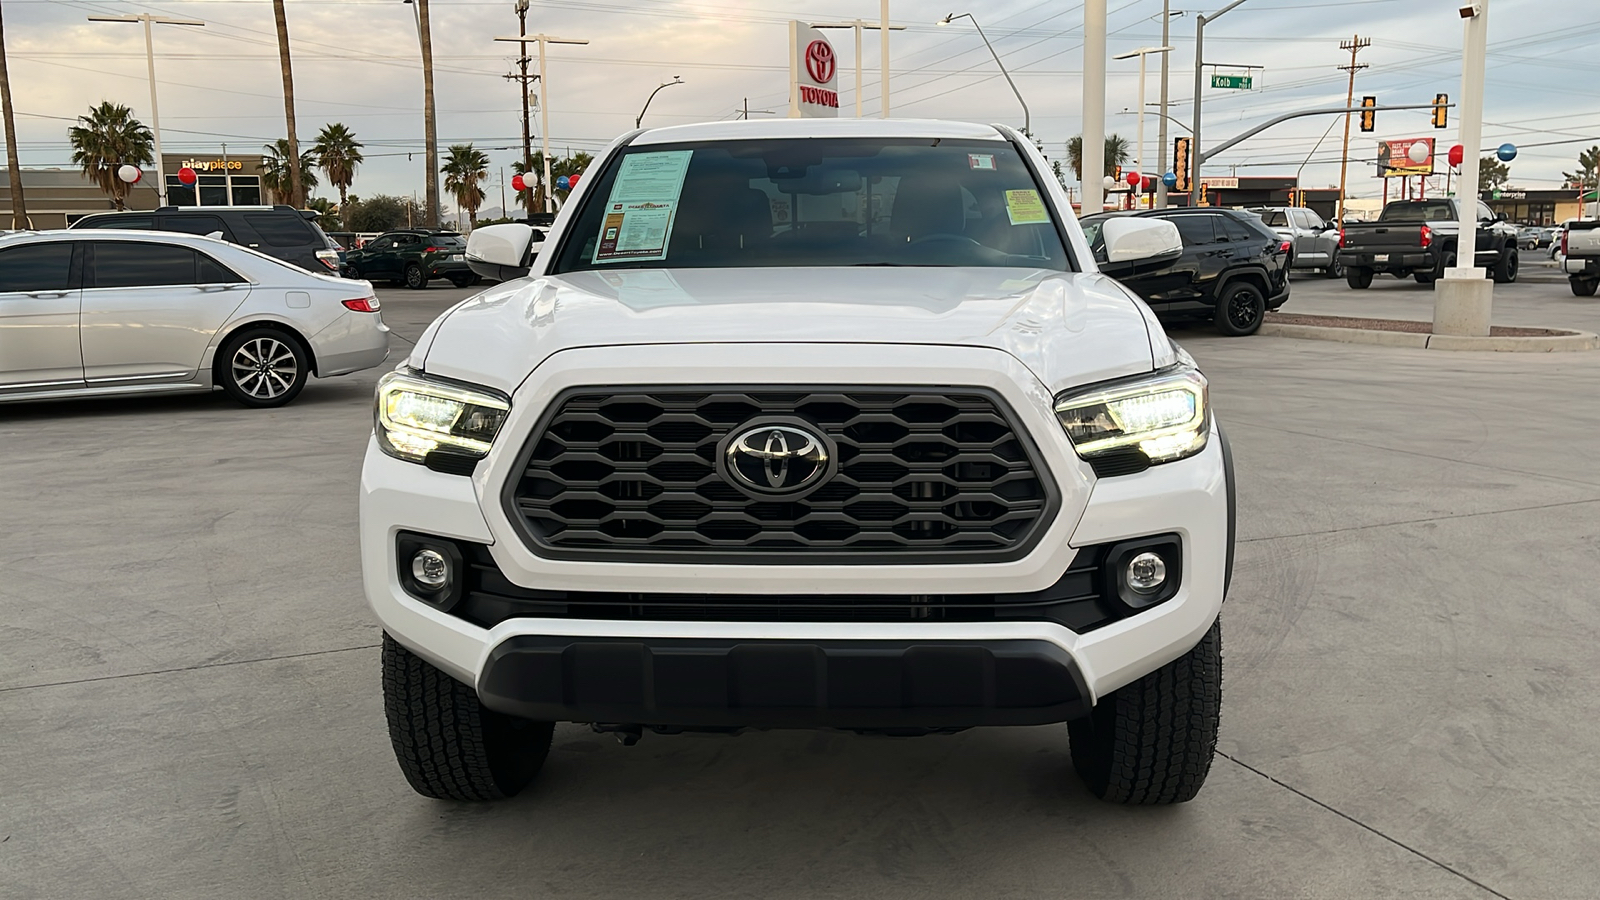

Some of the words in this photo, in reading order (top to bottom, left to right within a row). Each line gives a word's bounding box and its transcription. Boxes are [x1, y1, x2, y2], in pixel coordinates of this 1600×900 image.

[1216, 77, 1230, 87] Kolb
[800, 85, 840, 108] TOYOTA
[1493, 191, 1526, 199] enterprise
